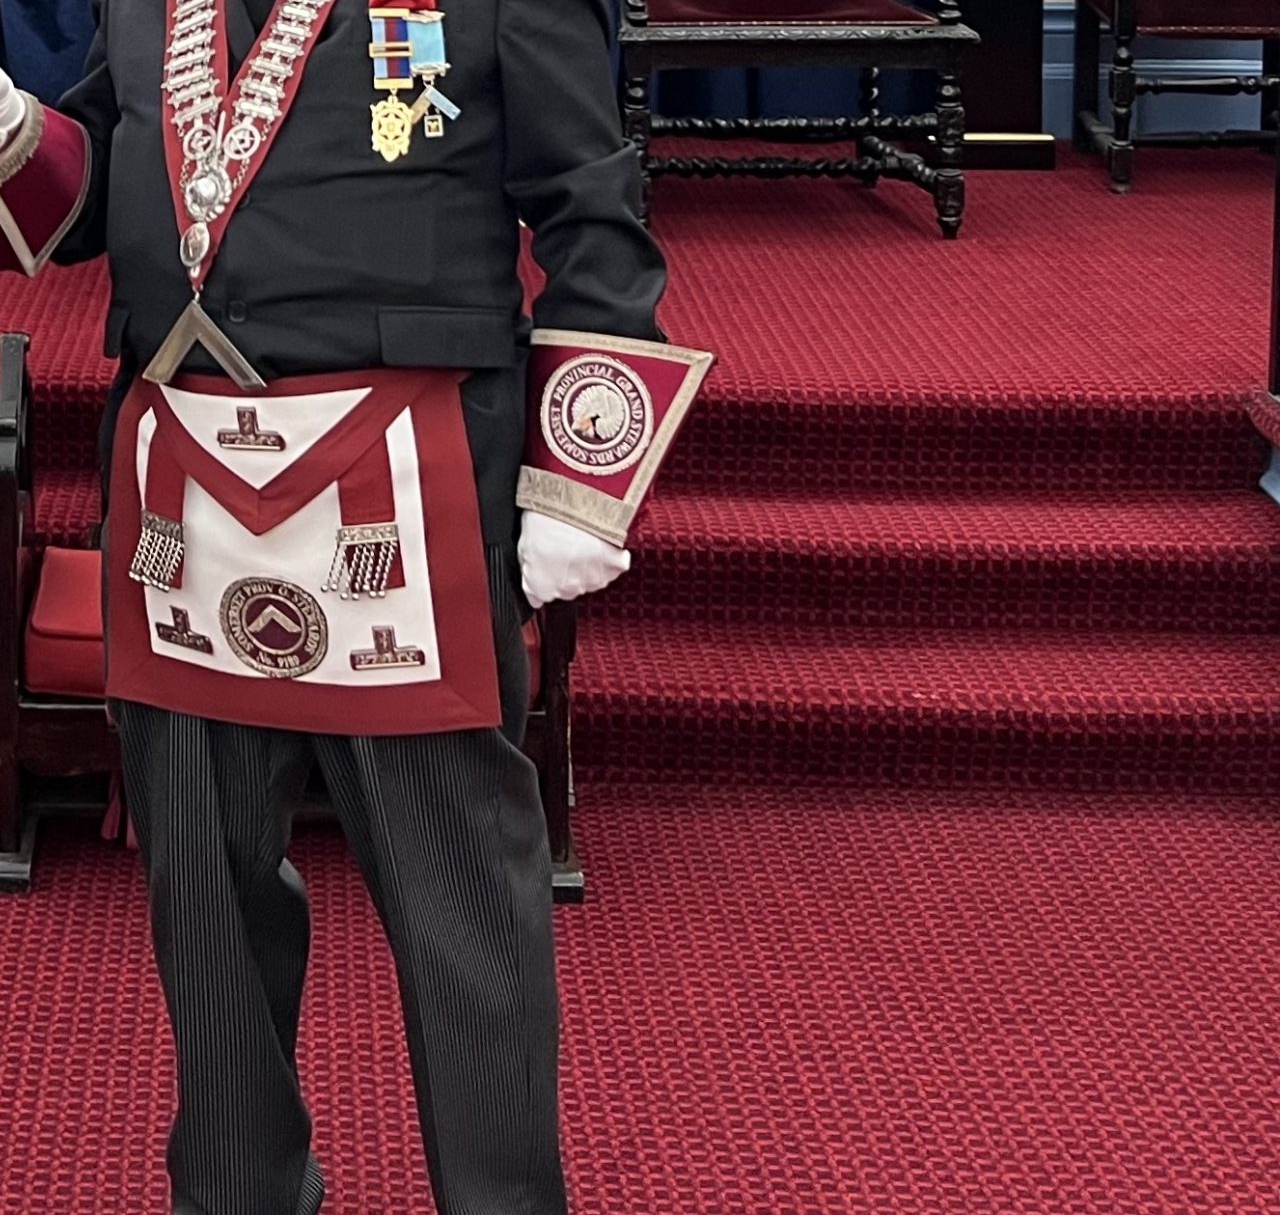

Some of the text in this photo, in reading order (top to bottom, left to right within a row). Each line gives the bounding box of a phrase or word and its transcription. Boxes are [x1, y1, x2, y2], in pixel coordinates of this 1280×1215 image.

[553, 364, 615, 402] PROVINCIAL
[615, 375, 644, 421] GRAND
[588, 420, 643, 465] STEWARDS
